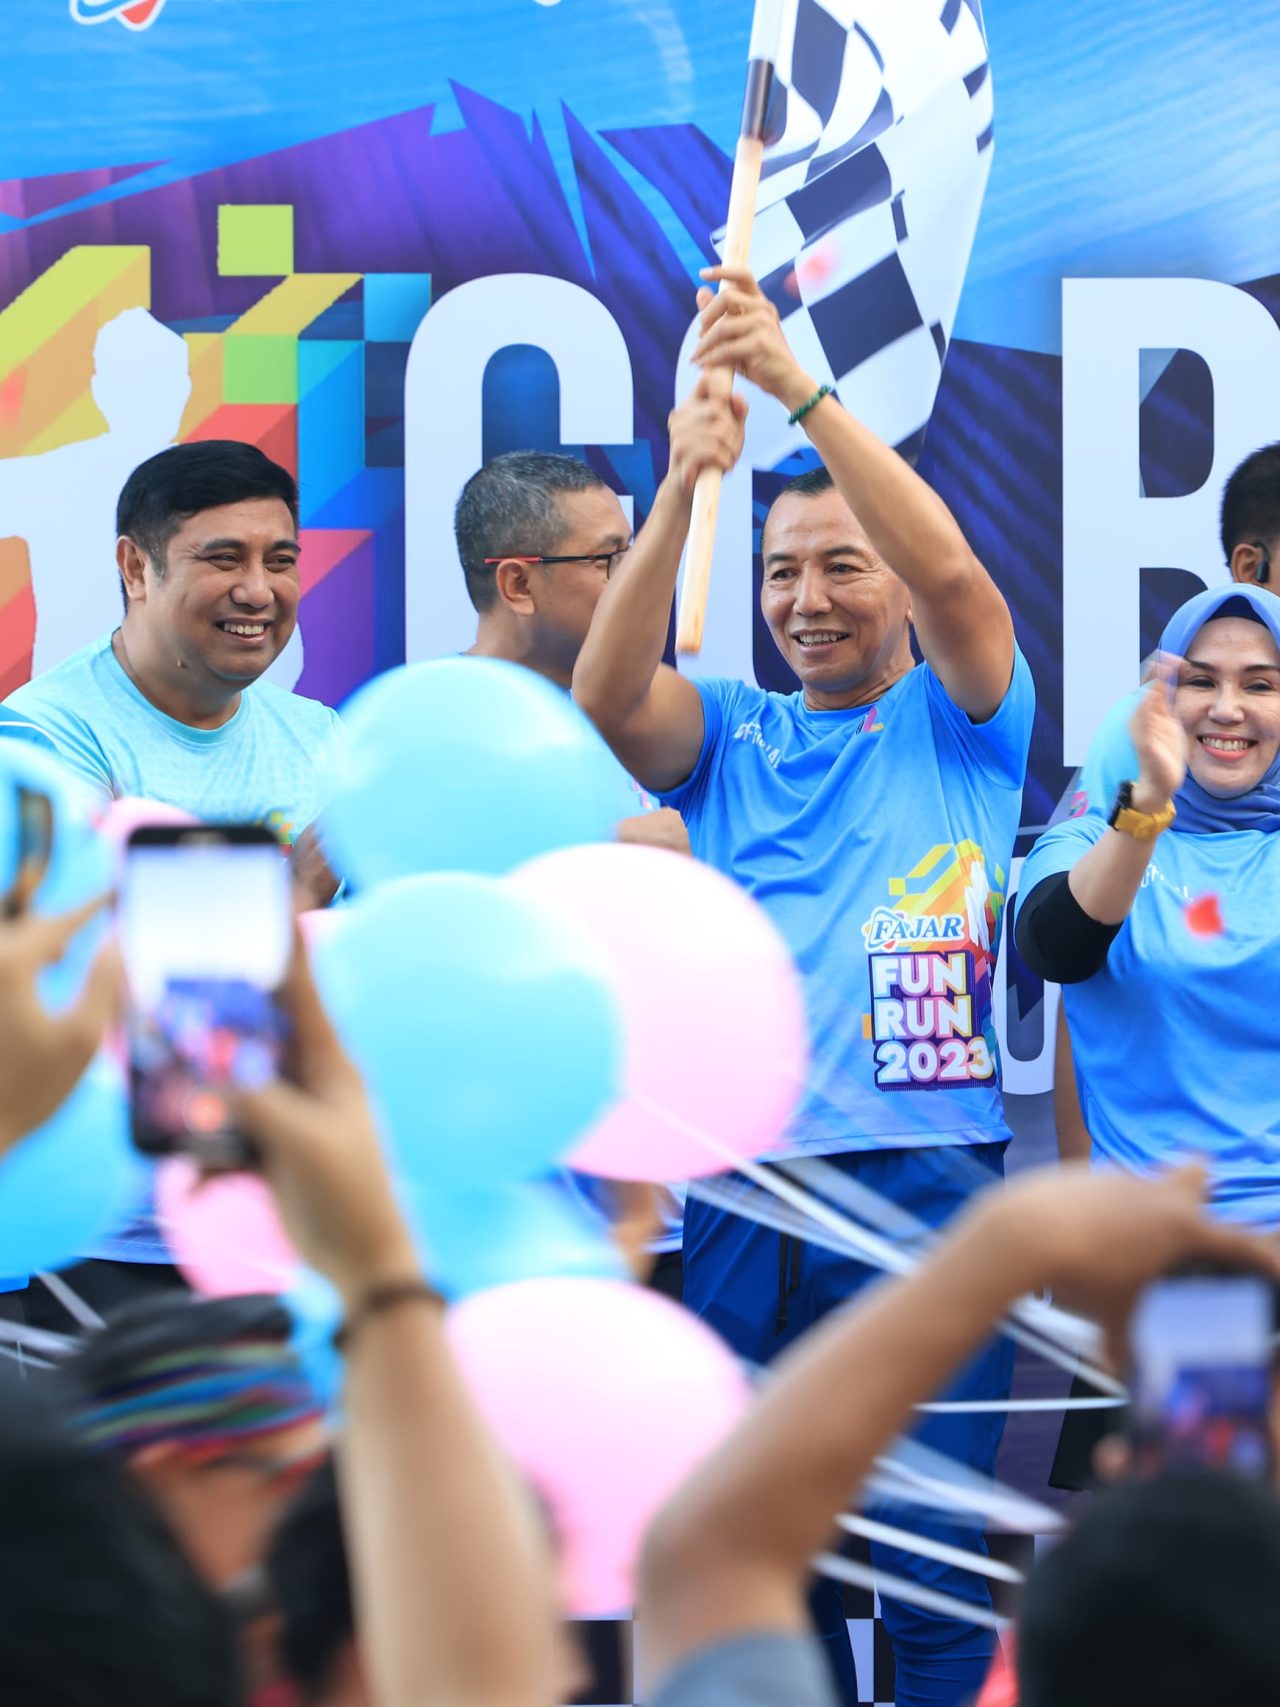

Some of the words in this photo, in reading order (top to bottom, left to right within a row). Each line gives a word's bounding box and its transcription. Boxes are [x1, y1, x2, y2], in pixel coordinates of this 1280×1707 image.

[872, 915, 963, 941] FAJAR
[871, 953, 967, 997] FUN
[874, 995, 973, 1041] RUN
[876, 1036, 994, 1083] 2023
